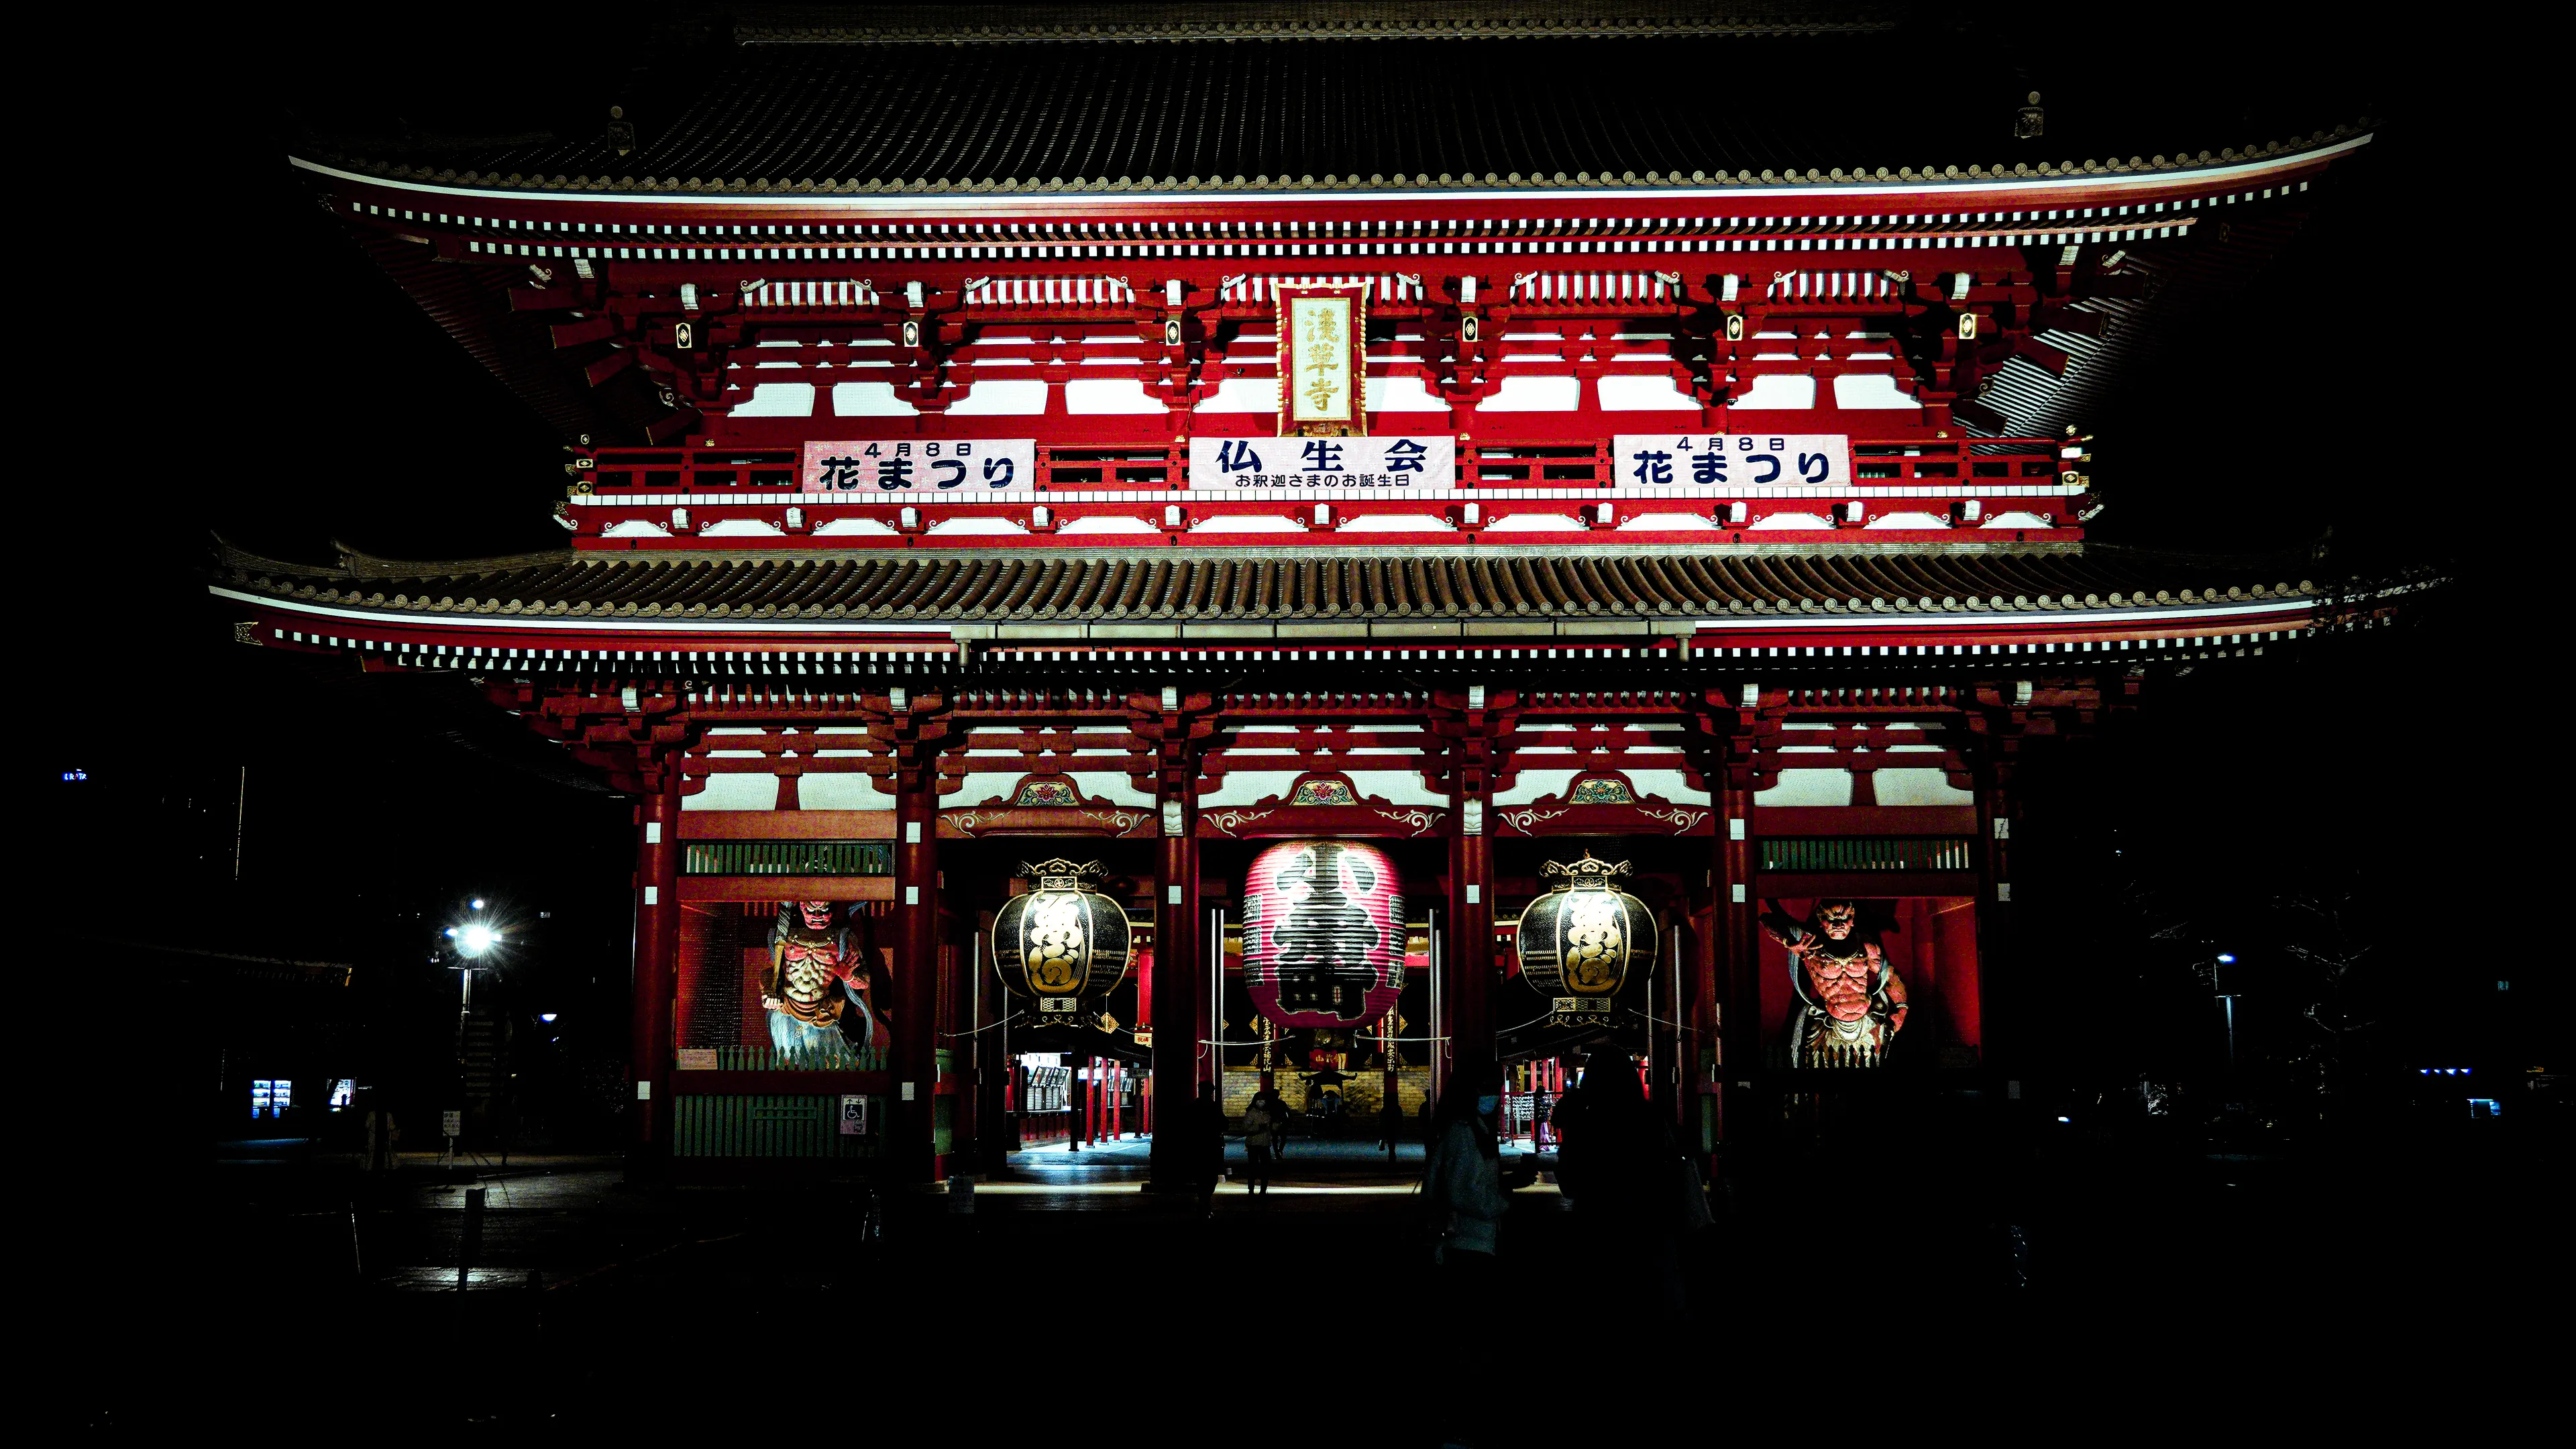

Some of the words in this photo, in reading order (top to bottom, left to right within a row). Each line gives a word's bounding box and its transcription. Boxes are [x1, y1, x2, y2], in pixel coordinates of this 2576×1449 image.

[865, 443, 971, 458] 4月8日
[1216, 439, 1428, 473] 仏生会
[1677, 437, 1784, 451] 4月8日
[819, 456, 1014, 490] 花まつり
[1633, 451, 1829, 484] 花まつり
[1236, 474, 1410, 488] お釈迦さまのお誕生日
